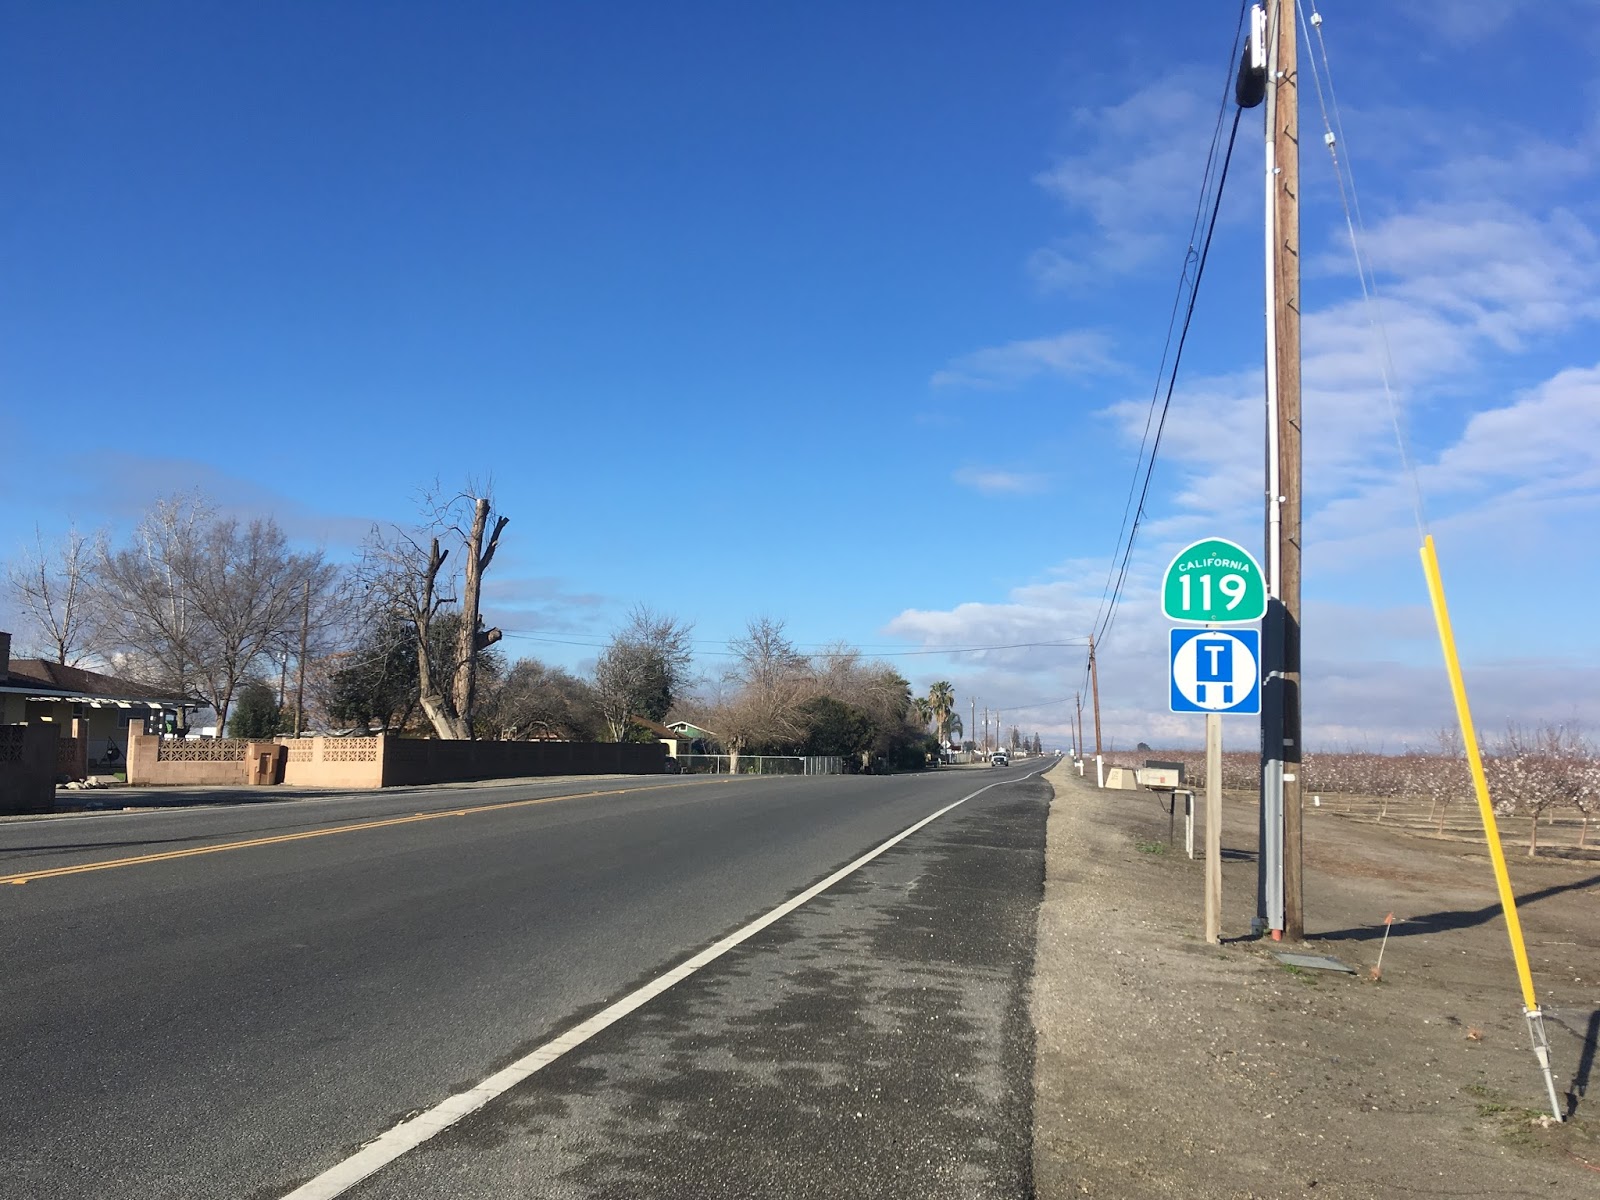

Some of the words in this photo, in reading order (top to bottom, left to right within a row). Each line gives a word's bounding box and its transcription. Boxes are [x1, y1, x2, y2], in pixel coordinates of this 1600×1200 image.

[1178, 558, 1250, 573] CALIFORNIA
[1179, 574, 1247, 611] 119
[1204, 645, 1225, 676] T
